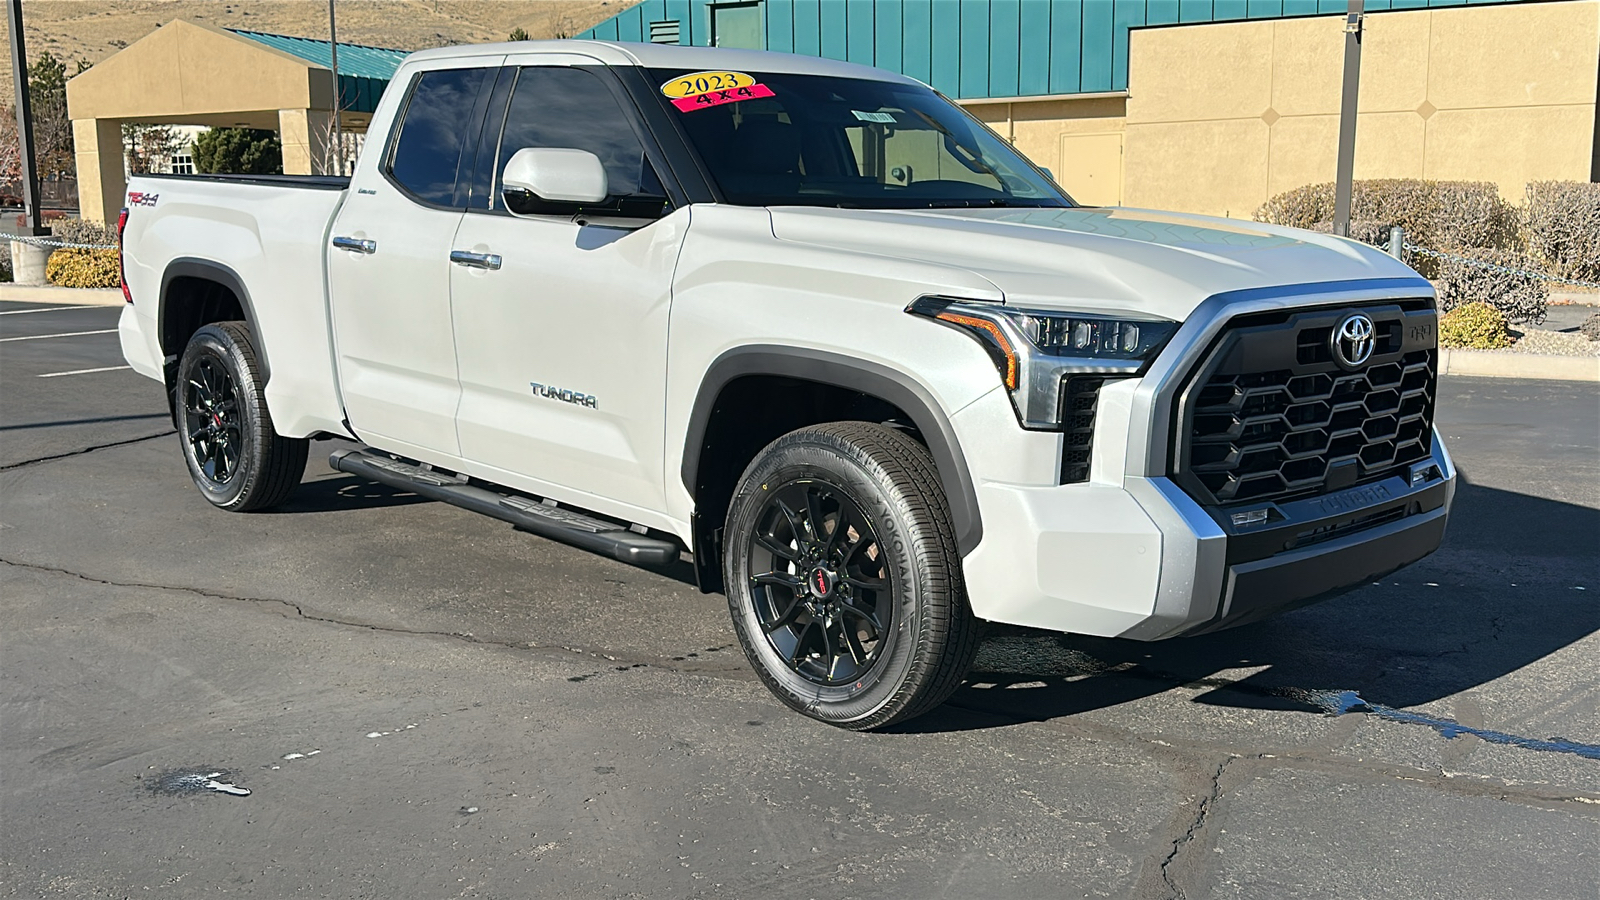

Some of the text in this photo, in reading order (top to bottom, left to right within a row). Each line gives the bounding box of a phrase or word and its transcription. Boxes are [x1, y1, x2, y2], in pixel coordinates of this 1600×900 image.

[680, 74, 739, 95] 2023
[529, 381, 599, 410] TUNDRA
[880, 507, 914, 607] YOKOHAMA
[816, 569, 827, 595] TRD
